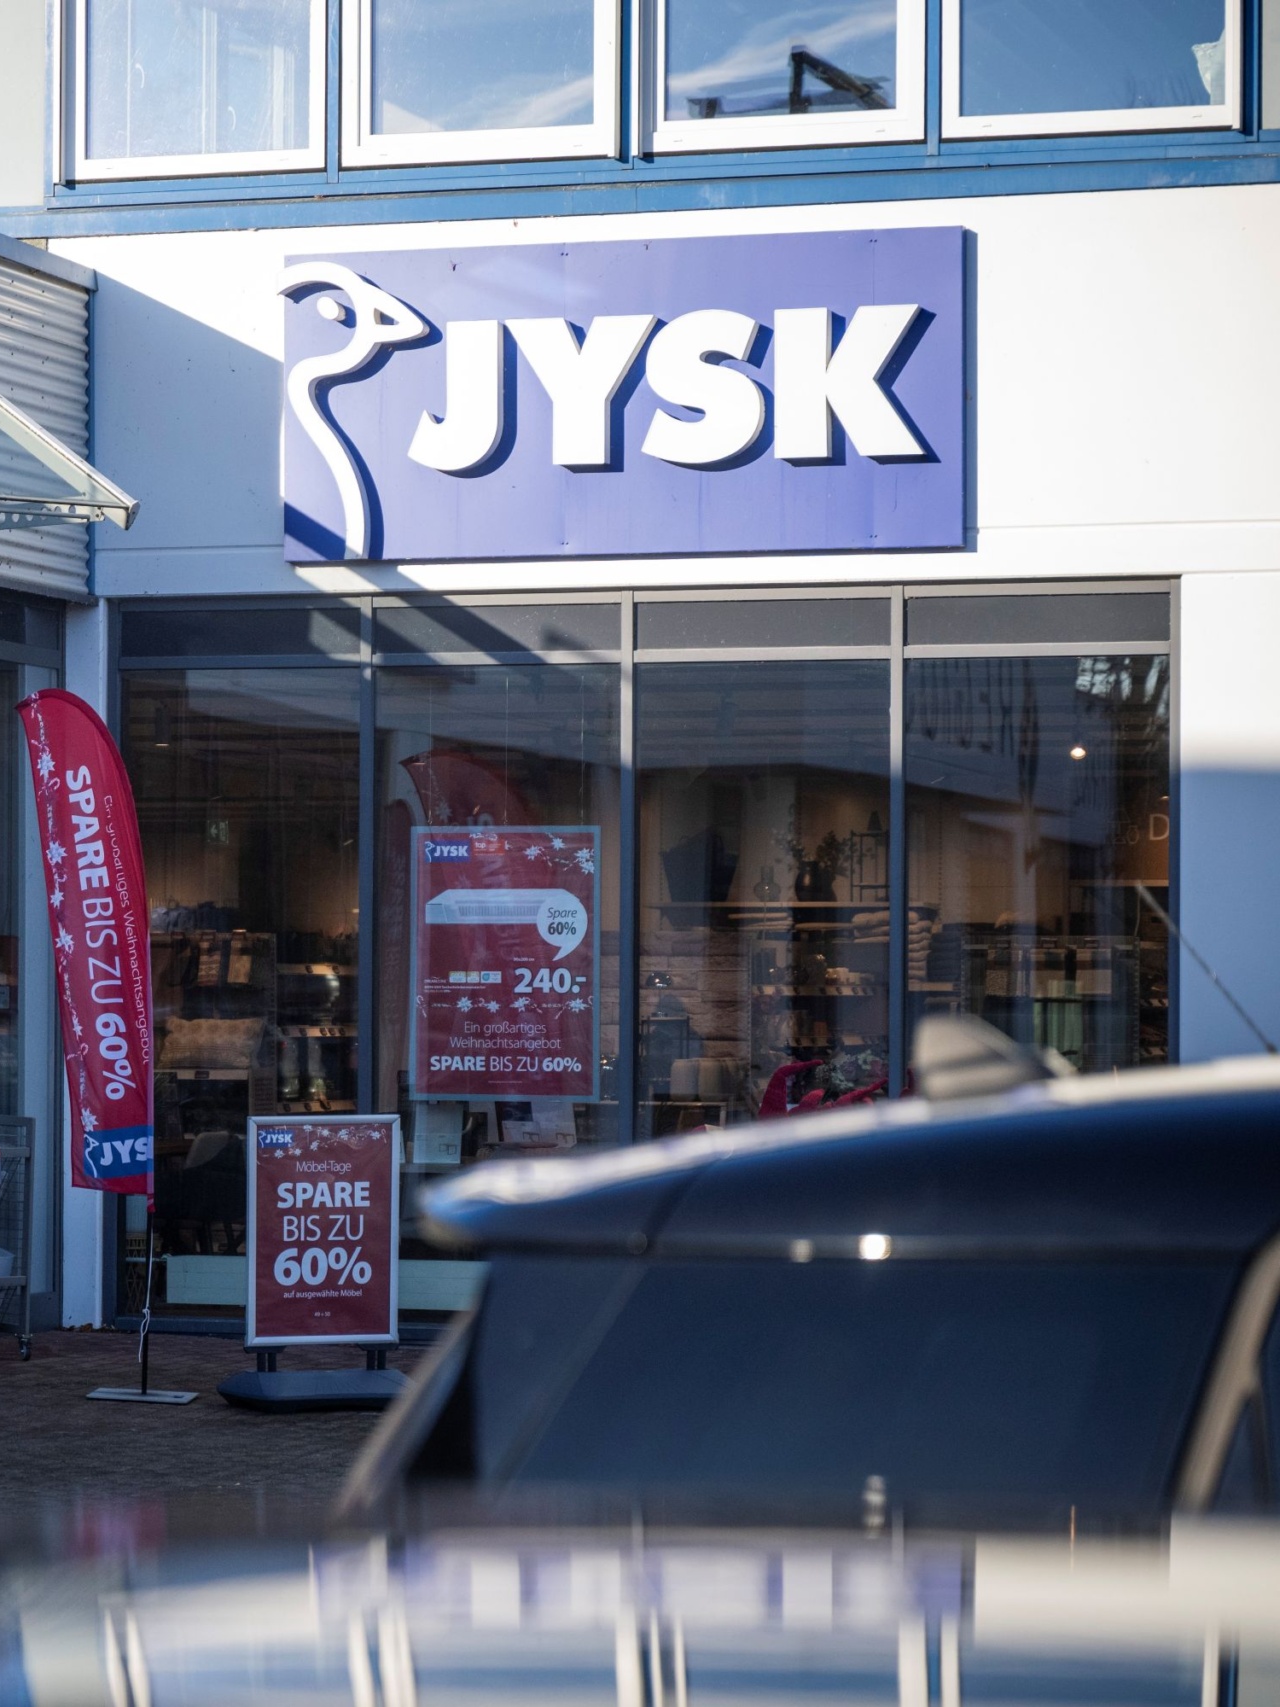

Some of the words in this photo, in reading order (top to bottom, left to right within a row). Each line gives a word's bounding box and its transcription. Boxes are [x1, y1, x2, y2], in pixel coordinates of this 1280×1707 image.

[407, 303, 928, 471] JYSK
[65, 765, 110, 891] SPARE
[434, 845, 469, 857] JYSK
[82, 896, 118, 949] BIS
[547, 906, 578, 920] Spare
[547, 921, 577, 936] 60%
[88, 956, 124, 1004] ZU
[464, 1020, 481, 1033] Ein
[483, 1020, 547, 1037] großartiges
[449, 1036, 562, 1051] Weihnachtsangebot
[95, 1012, 137, 1101] 60%
[429, 1055, 486, 1071] SPARE
[489, 1056, 513, 1072] BIS
[516, 1056, 539, 1072] ZU
[542, 1057, 582, 1072] 60%
[265, 1133, 293, 1144] JYSK
[100, 1135, 154, 1167] JYS
[296, 1160, 352, 1174] Möbel-Tage
[276, 1181, 371, 1209] SPARE
[283, 1214, 321, 1242] BIS
[327, 1214, 364, 1242] ZU
[273, 1246, 373, 1287] 60%
[283, 1290, 295, 1298] auf
[295, 1289, 339, 1300] ausgewählte
[340, 1288, 363, 1297] Möbel
